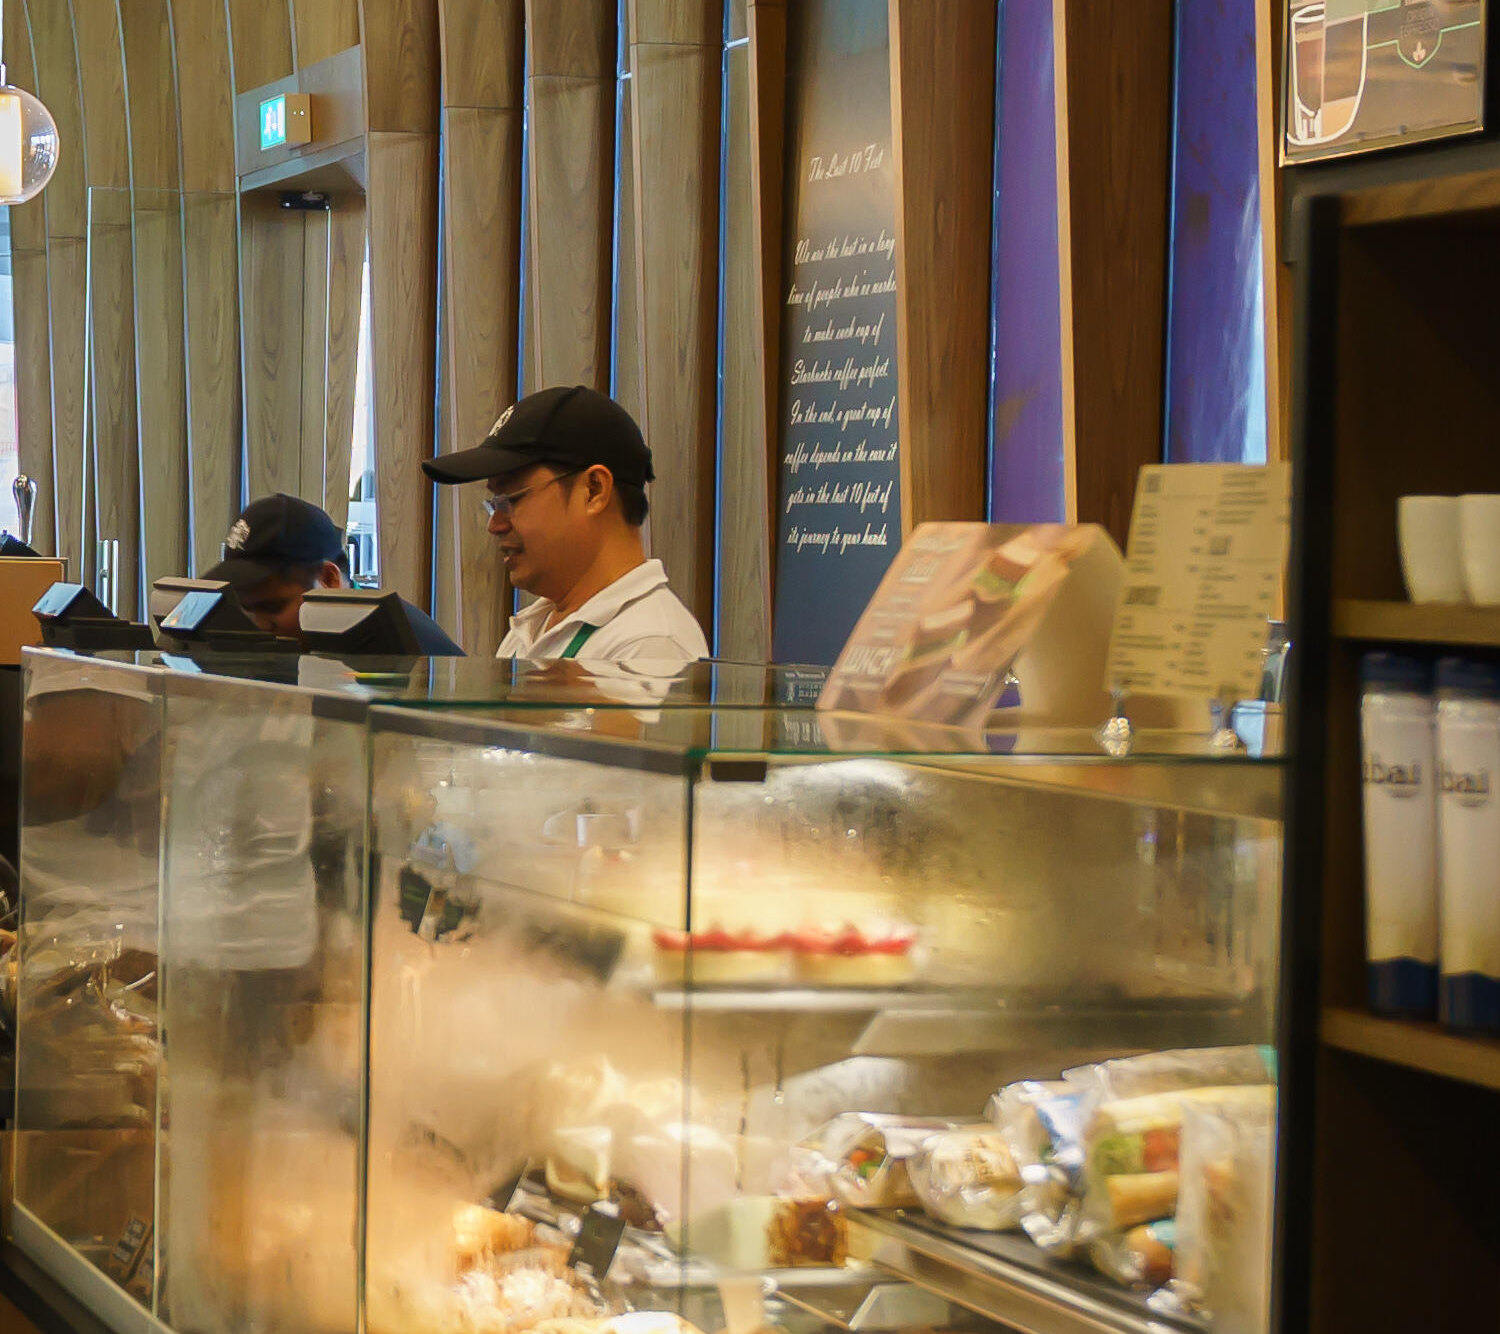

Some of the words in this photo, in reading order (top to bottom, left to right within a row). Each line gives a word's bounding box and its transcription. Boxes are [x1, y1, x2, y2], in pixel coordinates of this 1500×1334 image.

[808, 156, 824, 182] The
[825, 153, 848, 179] Last
[849, 151, 862, 173] 10
[864, 143, 883, 173] Feet
[824, 237, 839, 260] the
[840, 235, 858, 258] last
[858, 237, 867, 254] in
[868, 242, 875, 253] a
[805, 280, 818, 313] of
[813, 277, 842, 309] people
[802, 325, 812, 344] to
[812, 319, 835, 342] make
[855, 325, 871, 345] cup
[871, 312, 885, 346] of
[791, 359, 833, 385] Starbucks
[833, 357, 859, 391] coffee
[803, 401, 817, 424] the
[841, 401, 867, 432] great
[865, 407, 882, 427] cup
[882, 395, 896, 429] of
[784, 442, 809, 474] coffee
[808, 441, 842, 471] depends
[841, 450, 853, 463] on
[854, 439, 868, 462] the
[868, 450, 887, 462] care
[886, 441, 898, 461] it
[785, 486, 805, 514] gets
[805, 487, 816, 504] in
[815, 481, 830, 504] the
[830, 482, 850, 504] last
[850, 482, 864, 504] 10
[860, 481, 881, 514] feet
[879, 480, 894, 514] of
[797, 527, 831, 555] journey
[830, 526, 840, 544] to
[840, 533, 861, 555] your
